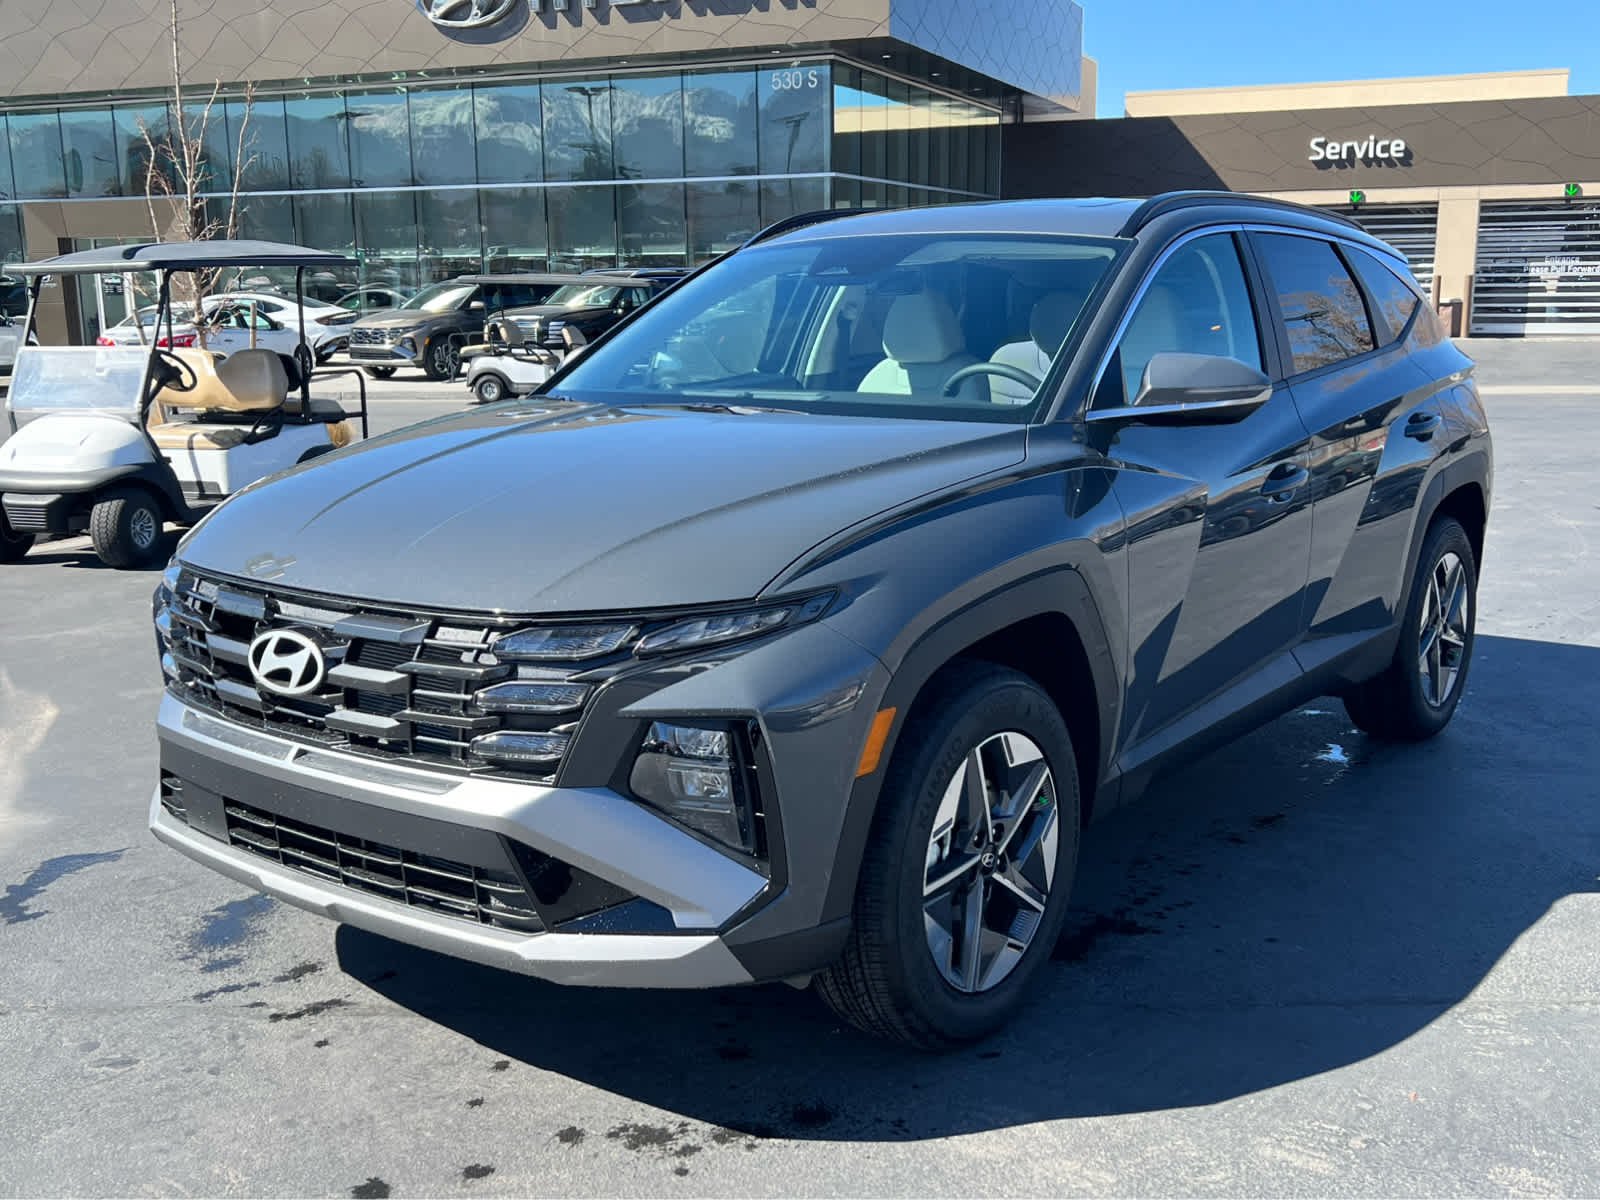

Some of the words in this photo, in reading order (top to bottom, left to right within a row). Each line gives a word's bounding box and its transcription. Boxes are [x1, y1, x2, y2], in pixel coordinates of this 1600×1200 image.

[771, 71, 803, 91] 530
[807, 69, 818, 89] S
[1308, 134, 1406, 160] Service
[1523, 264, 1550, 273] Please
